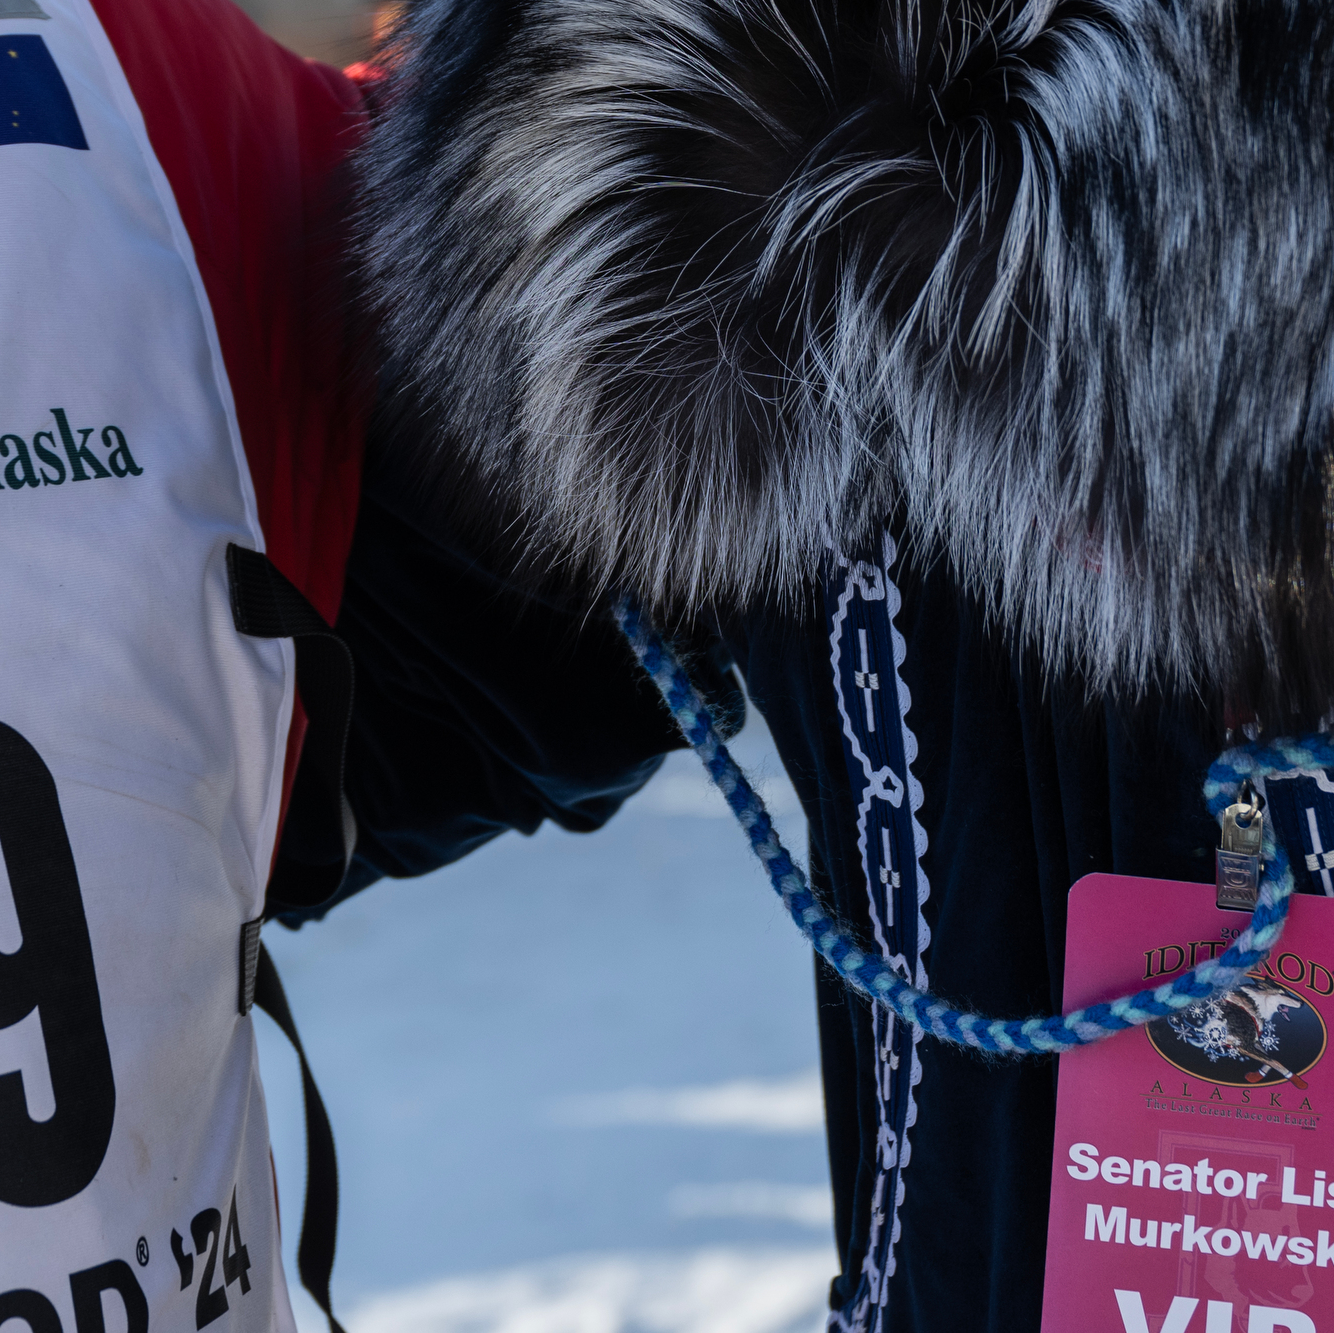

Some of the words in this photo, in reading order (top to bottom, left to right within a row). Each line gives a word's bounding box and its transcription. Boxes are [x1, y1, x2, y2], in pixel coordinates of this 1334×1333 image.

[1145, 1098, 1167, 1110] The
[1171, 1101, 1196, 1114] Last
[1199, 1104, 1231, 1118] Great
[1235, 1108, 1263, 1121] Race
[1266, 1114, 1281, 1123] on
[1150, 1080, 1313, 1111] ALASKA
[1067, 1142, 1268, 1200] Senator
